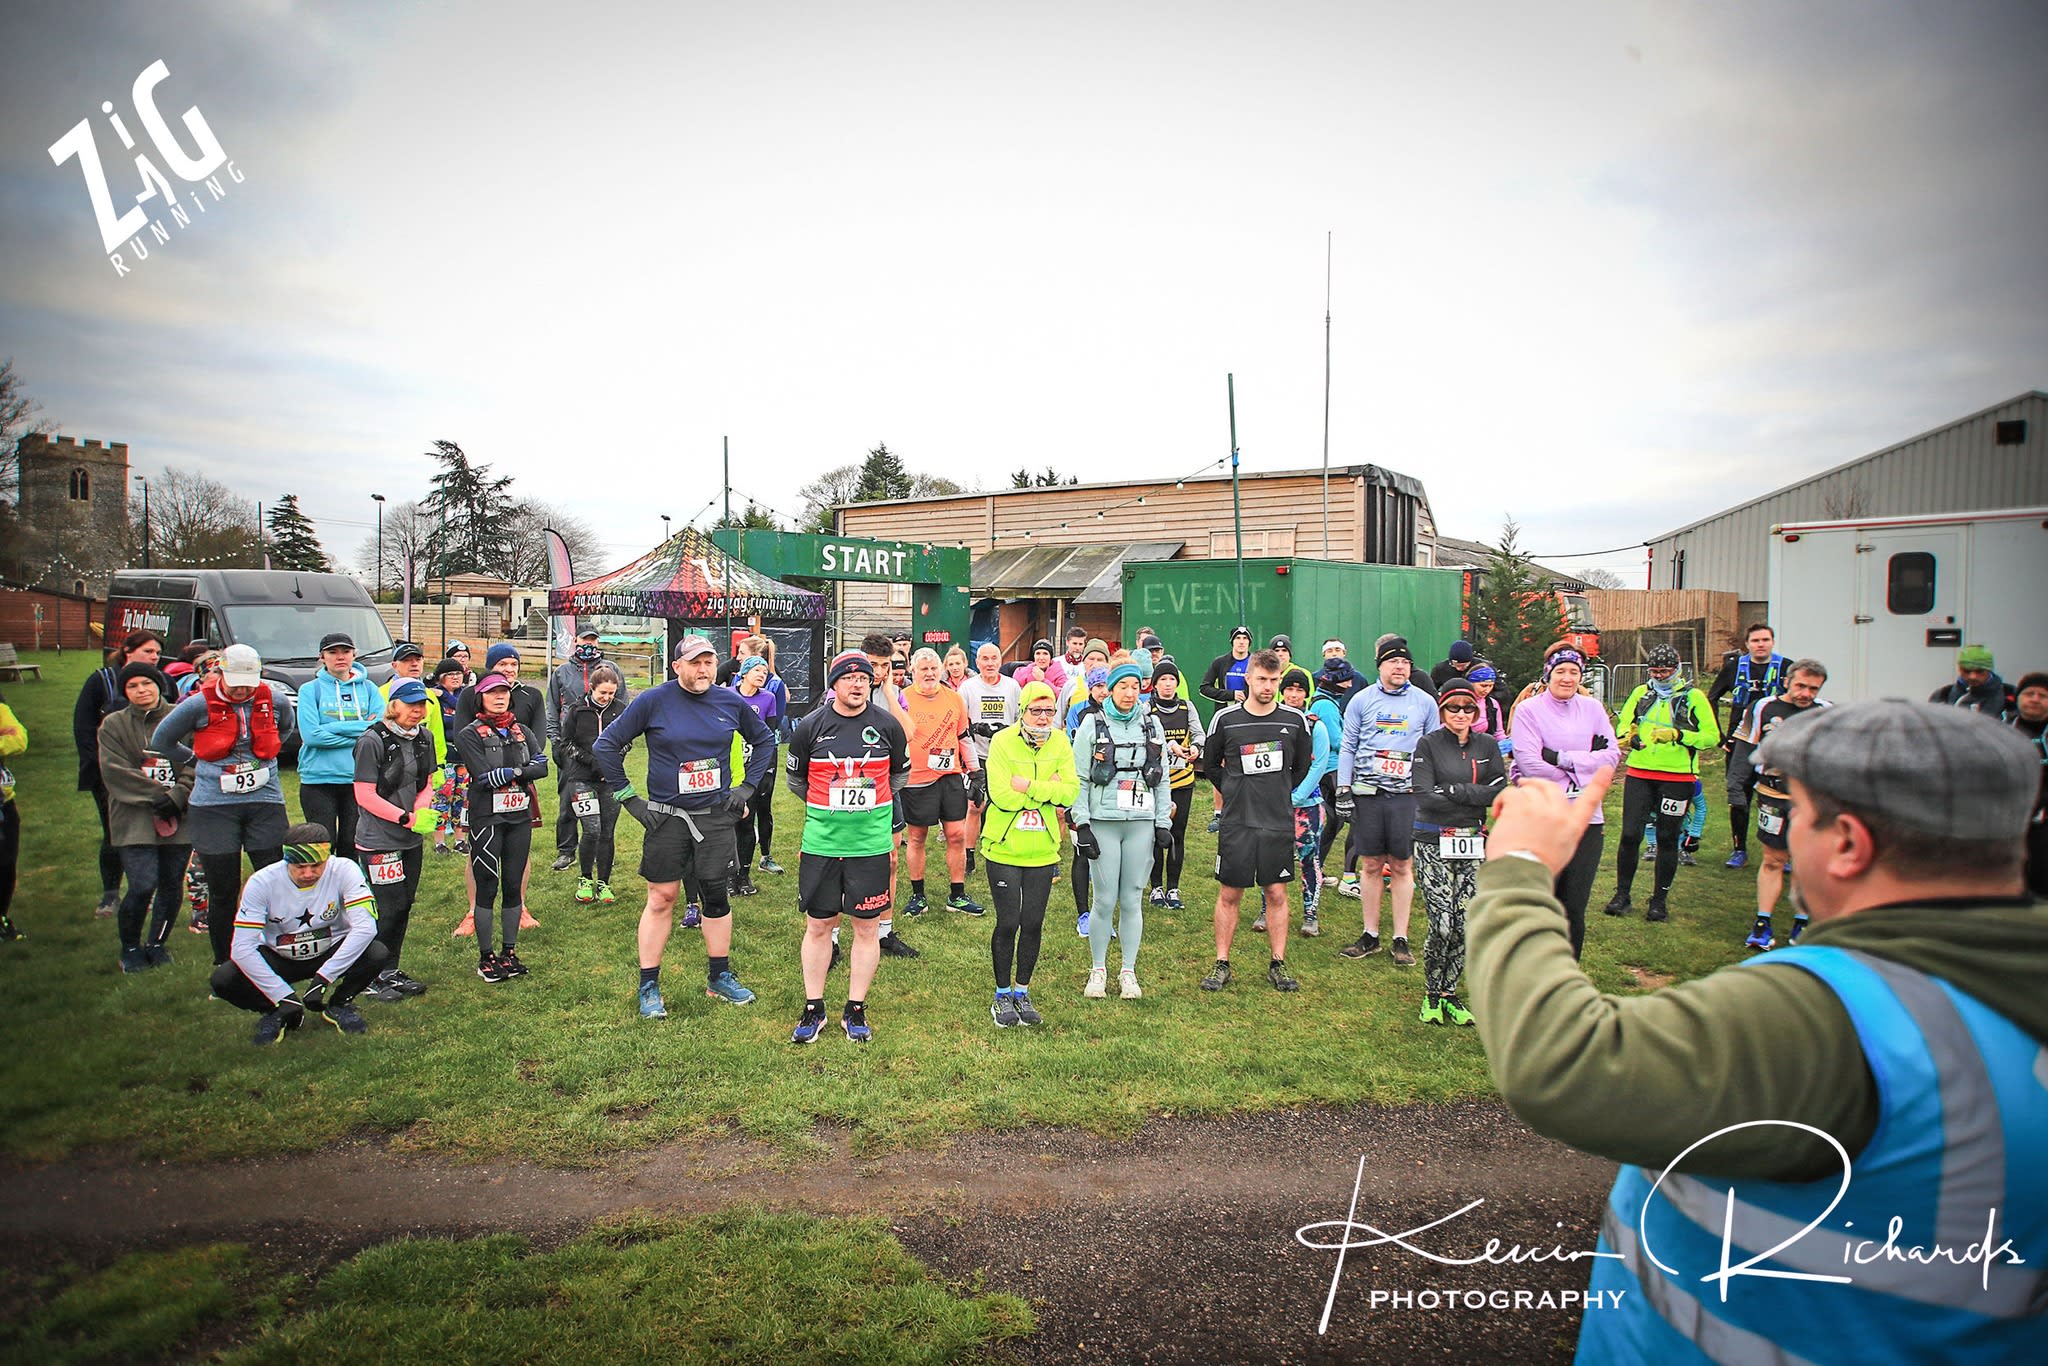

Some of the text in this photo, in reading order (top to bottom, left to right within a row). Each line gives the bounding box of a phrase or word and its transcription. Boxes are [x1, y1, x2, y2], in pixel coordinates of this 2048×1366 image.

[821, 544, 906, 577] START
[574, 593, 586, 610] zig
[603, 592, 636, 612] running
[707, 595, 724, 614] zig
[750, 596, 793, 614] running
[1143, 582, 1266, 614] EVENT
[143, 610, 171, 637] Running
[982, 702, 1004, 711] 2009
[937, 756, 951, 769] 78
[1255, 754, 1271, 769] 68
[1381, 760, 1405, 775] 498
[236, 772, 256, 789] 93
[688, 771, 715, 789] 488
[841, 789, 866, 806] 126
[1662, 800, 1678, 812] 66
[578, 801, 592, 813] 55
[1452, 838, 1473, 854] 101
[377, 862, 403, 880] 463
[291, 942, 318, 957] 131
